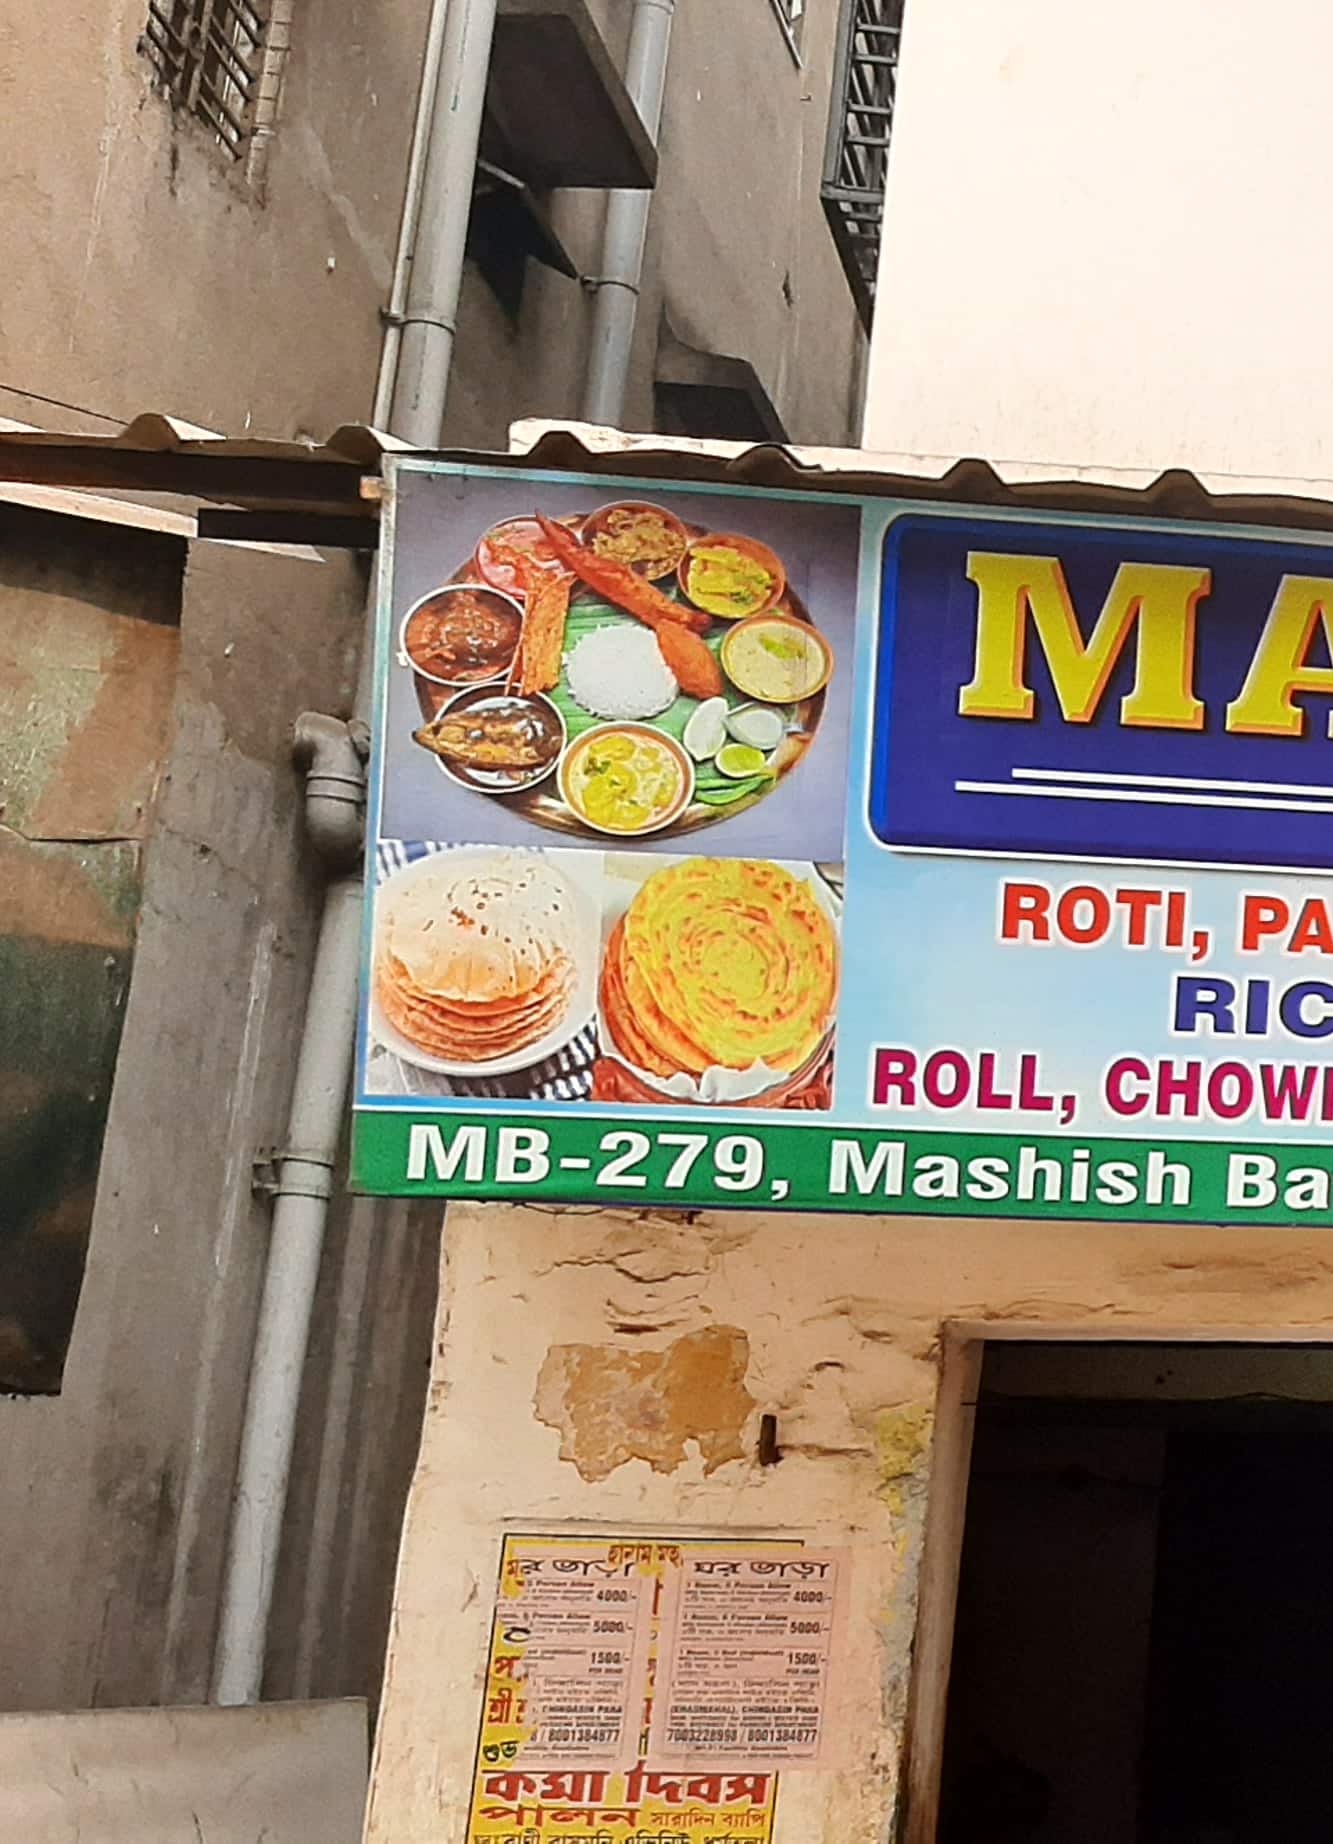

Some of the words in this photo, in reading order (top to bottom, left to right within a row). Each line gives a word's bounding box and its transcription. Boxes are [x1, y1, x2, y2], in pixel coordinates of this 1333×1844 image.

[1001, 883, 1210, 960] ROTI,
[873, 1048, 1077, 1124] ROLL,
[406, 1125, 791, 1201] MB-279,
[828, 1139, 1191, 1207] Mashish
[694, 1561, 742, 1577] ঘর
[750, 1561, 830, 1579] ভাড়া
